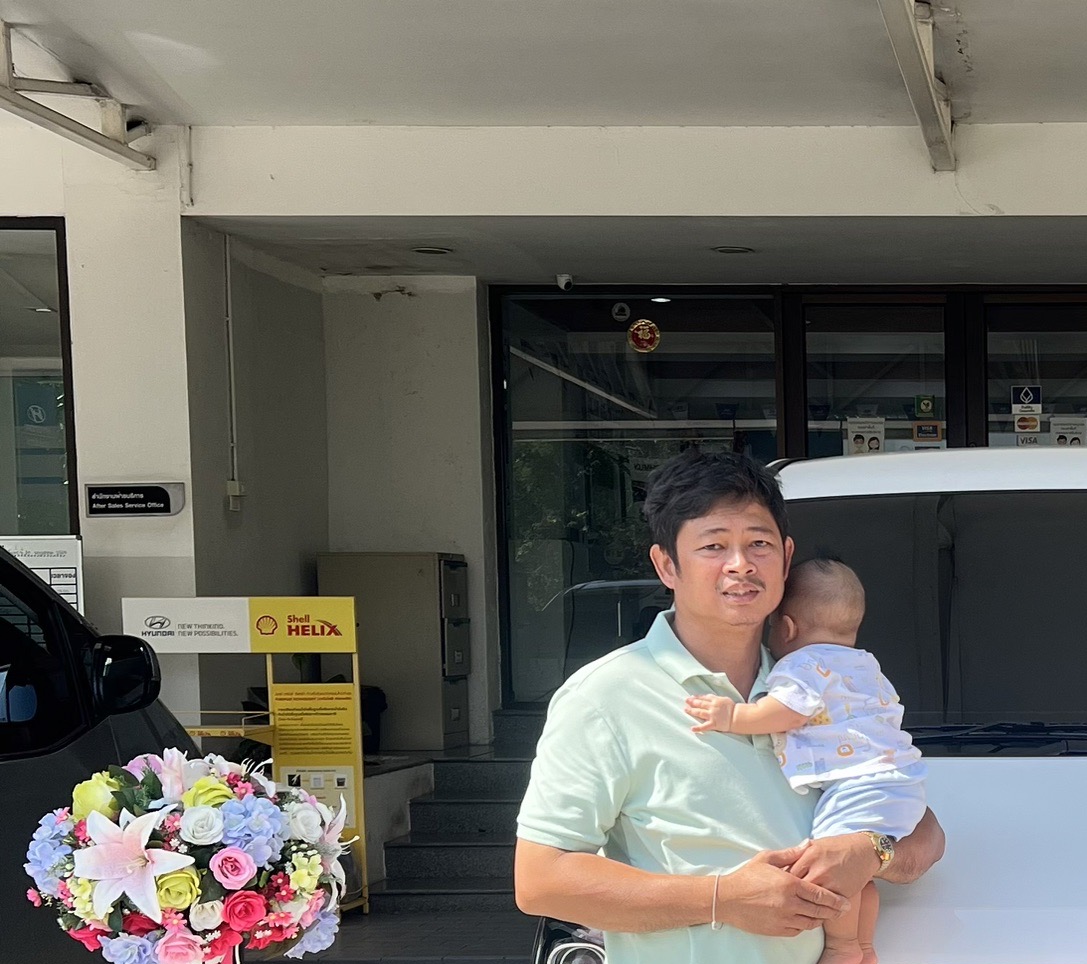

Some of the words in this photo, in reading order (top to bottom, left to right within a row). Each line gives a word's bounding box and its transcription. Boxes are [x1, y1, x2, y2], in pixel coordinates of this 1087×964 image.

[1019, 435, 1038, 445] VISA
[287, 615, 310, 623] Shell
[287, 625, 342, 636] HELIX
